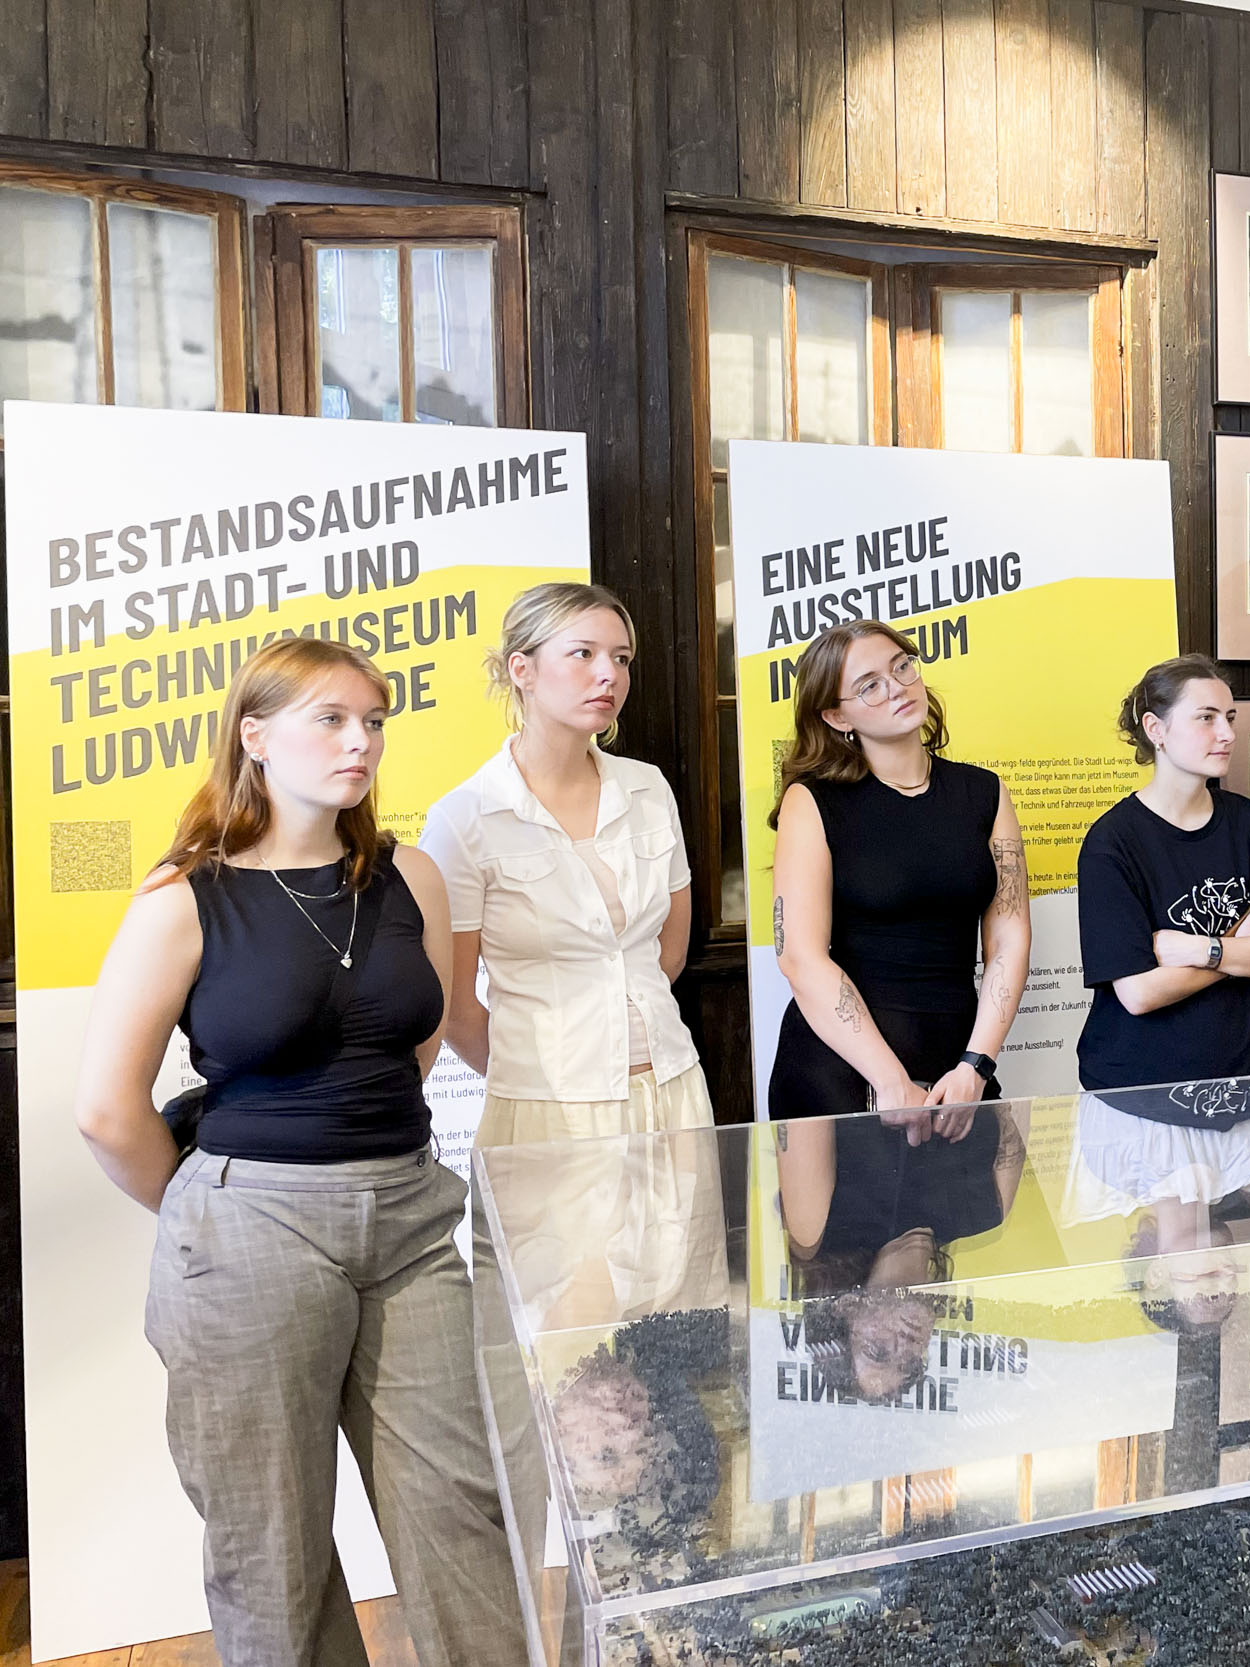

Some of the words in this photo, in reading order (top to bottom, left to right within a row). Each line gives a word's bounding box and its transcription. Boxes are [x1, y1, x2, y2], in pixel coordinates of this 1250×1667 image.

[49, 448, 568, 588] BESTANDSAUFNAHME
[762, 539, 845, 597] EINE
[856, 516, 949, 575] NEUE
[51, 600, 104, 656] IM
[125, 563, 307, 641] STADT-
[325, 540, 420, 600] UND
[767, 551, 1022, 649] AUSSTELLUNG
[51, 591, 477, 723] TECHNISEUM
[1073, 757, 1084, 766] Die
[1085, 757, 1102, 766] Stadt
[1014, 772, 1033, 781] Diese
[1034, 772, 1052, 782] Dinge
[1054, 771, 1070, 780] kann
[1071, 772, 1086, 780] man
[1087, 770, 1101, 781] jetzt
[1103, 770, 1111, 779] im
[1112, 770, 1139, 779] Museum
[1026, 787, 1041, 795] dass
[1063, 786, 1078, 794] über
[1080, 785, 1091, 793] das
[1092, 784, 1112, 793] Leben
[1113, 783, 1133, 793] früher
[1020, 801, 1045, 810] Technik
[1046, 800, 1059, 809] und
[1061, 799, 1094, 810] Fahrzeuge
[1029, 822, 1044, 831] viele
[1045, 822, 1071, 831] Museen
[1072, 821, 1083, 829] auf
[1032, 836, 1052, 845] früher
[1054, 836, 1074, 846] gelebt
[1033, 872, 1054, 881] heute.
[1054, 967, 1066, 975] wie
[1067, 965, 1078, 974] die
[1031, 981, 1061, 991] aussieht.
[1018, 1005, 1040, 1014] useum
[1041, 1003, 1048, 1012] in
[1049, 1003, 1060, 1012] der
[1061, 999, 1087, 1011] Zukunft
[1006, 1044, 1023, 1052] neue
[1024, 1039, 1064, 1050] Ausstellung!
[181, 1076, 202, 1087] Eine
[432, 1090, 448, 1100] mit
[451, 1087, 487, 1098] Ludwig
[446, 1130, 461, 1141] der
